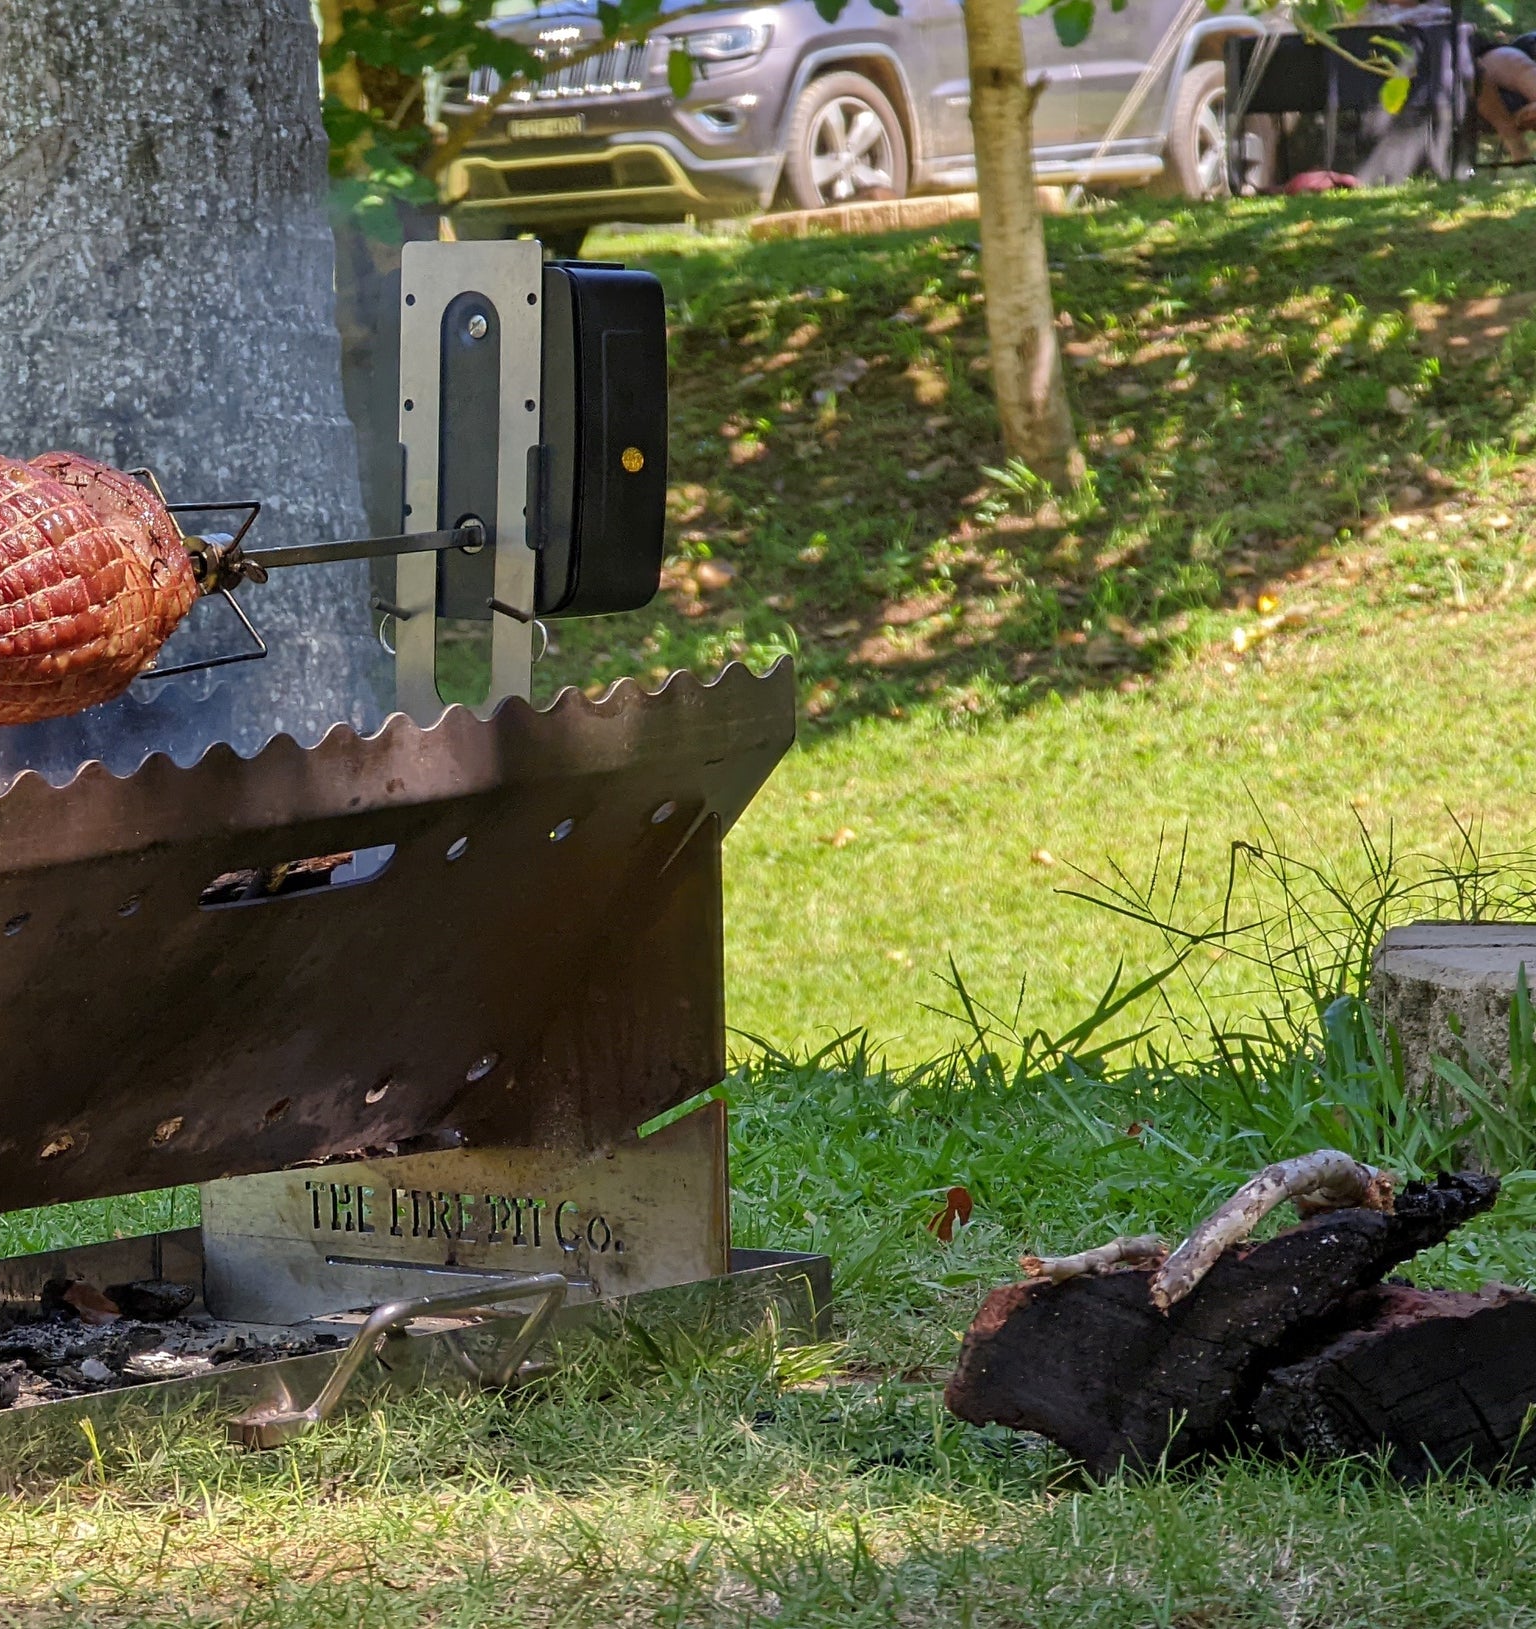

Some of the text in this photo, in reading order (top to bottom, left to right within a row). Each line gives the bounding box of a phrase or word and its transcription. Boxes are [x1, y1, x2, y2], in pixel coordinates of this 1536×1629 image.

[305, 1180, 376, 1234] THE
[390, 1188, 478, 1243] FIRE
[485, 1194, 547, 1248] PIT
